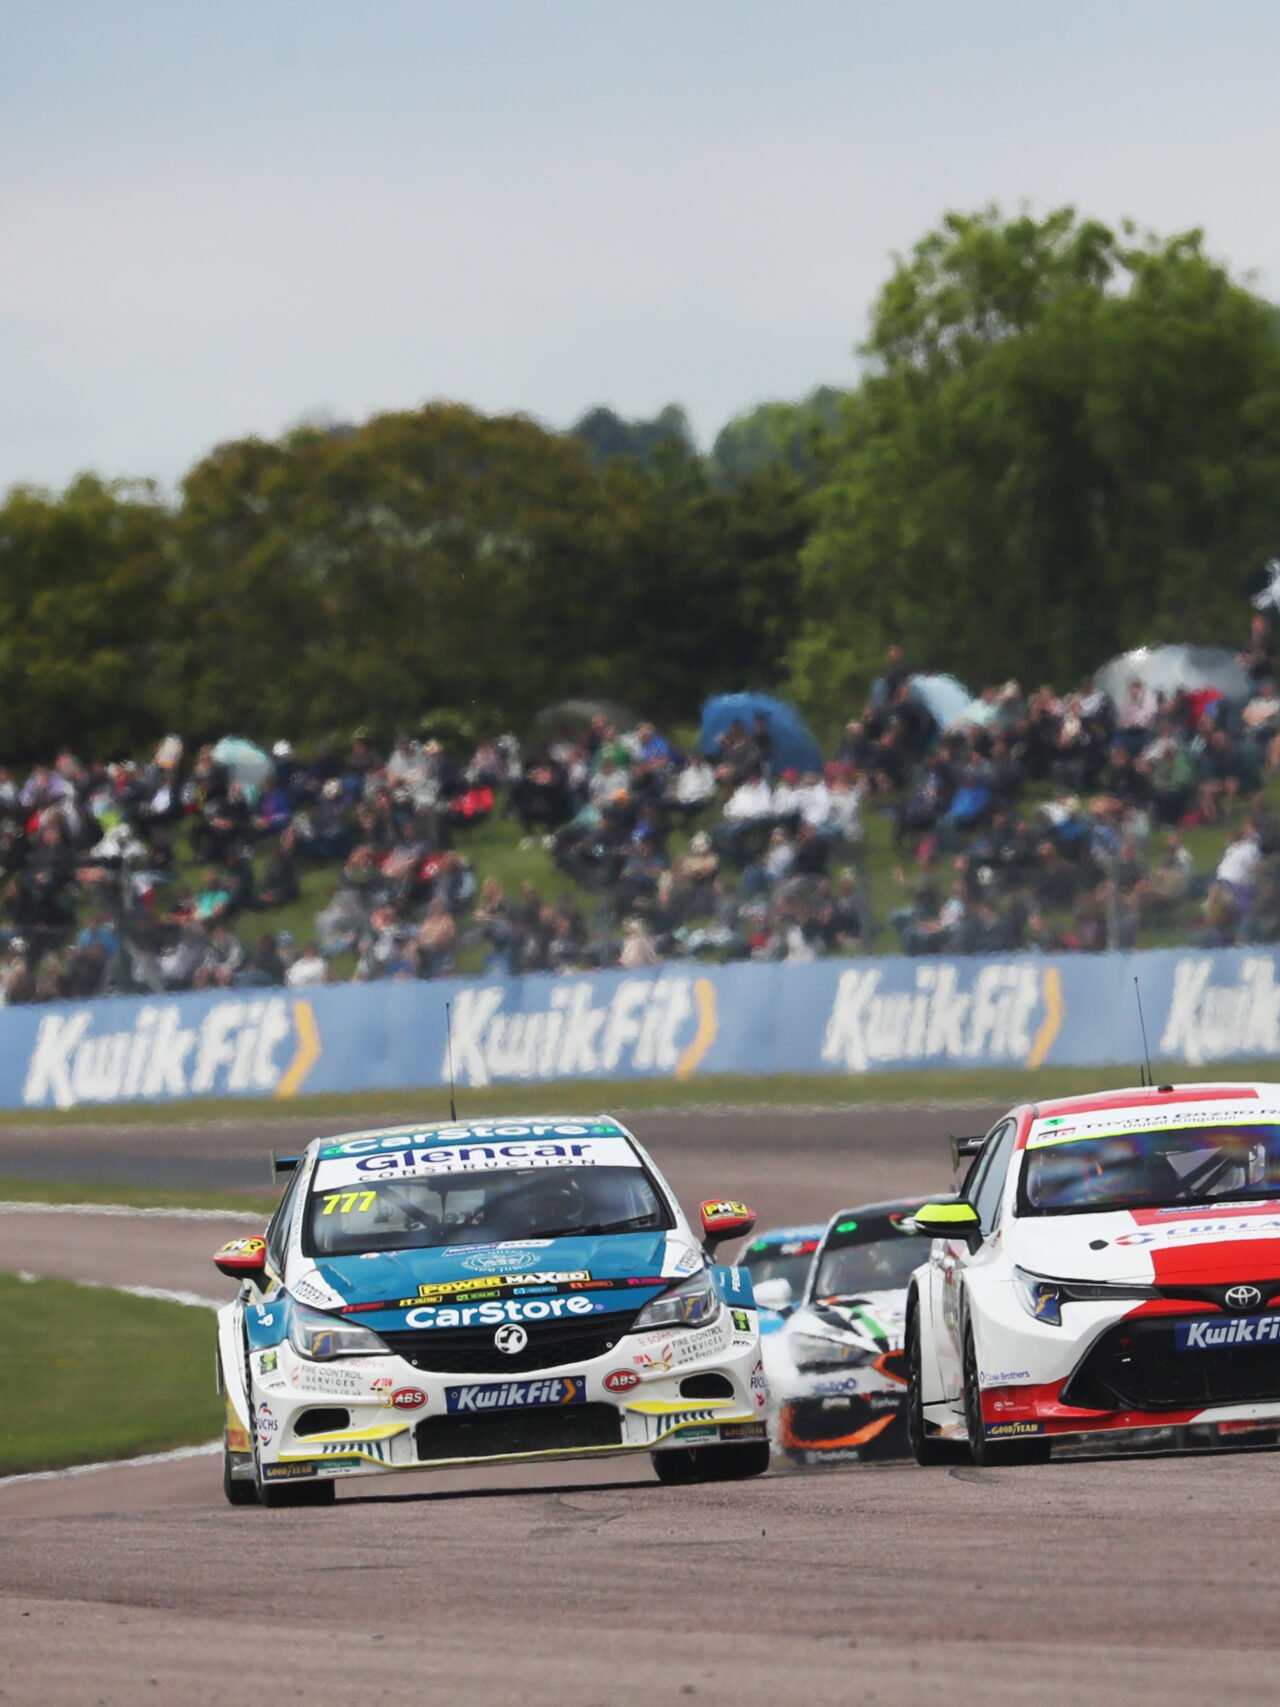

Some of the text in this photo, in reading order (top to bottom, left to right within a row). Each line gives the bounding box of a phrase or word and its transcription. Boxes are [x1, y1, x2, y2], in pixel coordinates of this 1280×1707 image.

[1122, 1114, 1237, 1129] United Kingdom
[341, 1124, 589, 1152] CarStore
[356, 1142, 592, 1171] Glencar
[358, 1159, 597, 1182] CONSTRUCTION
[322, 1190, 377, 1215] 777
[423, 1276, 501, 1294] POWER
[505, 1271, 586, 1284] MAXED
[405, 1296, 594, 1329] CarStore
[672, 1326, 723, 1349] FIRE CONTROL
[681, 1336, 723, 1355] SERVICES
[301, 1364, 363, 1380] FIRE CONTROL
[305, 1375, 356, 1388] SERVICES
[609, 1375, 636, 1388] ABS
[750, 1376, 766, 1389] FUC
[395, 1392, 422, 1405] ABS
[991, 1422, 1038, 1435] GOODYEAR
[266, 1464, 313, 1477] GOODYEAR
